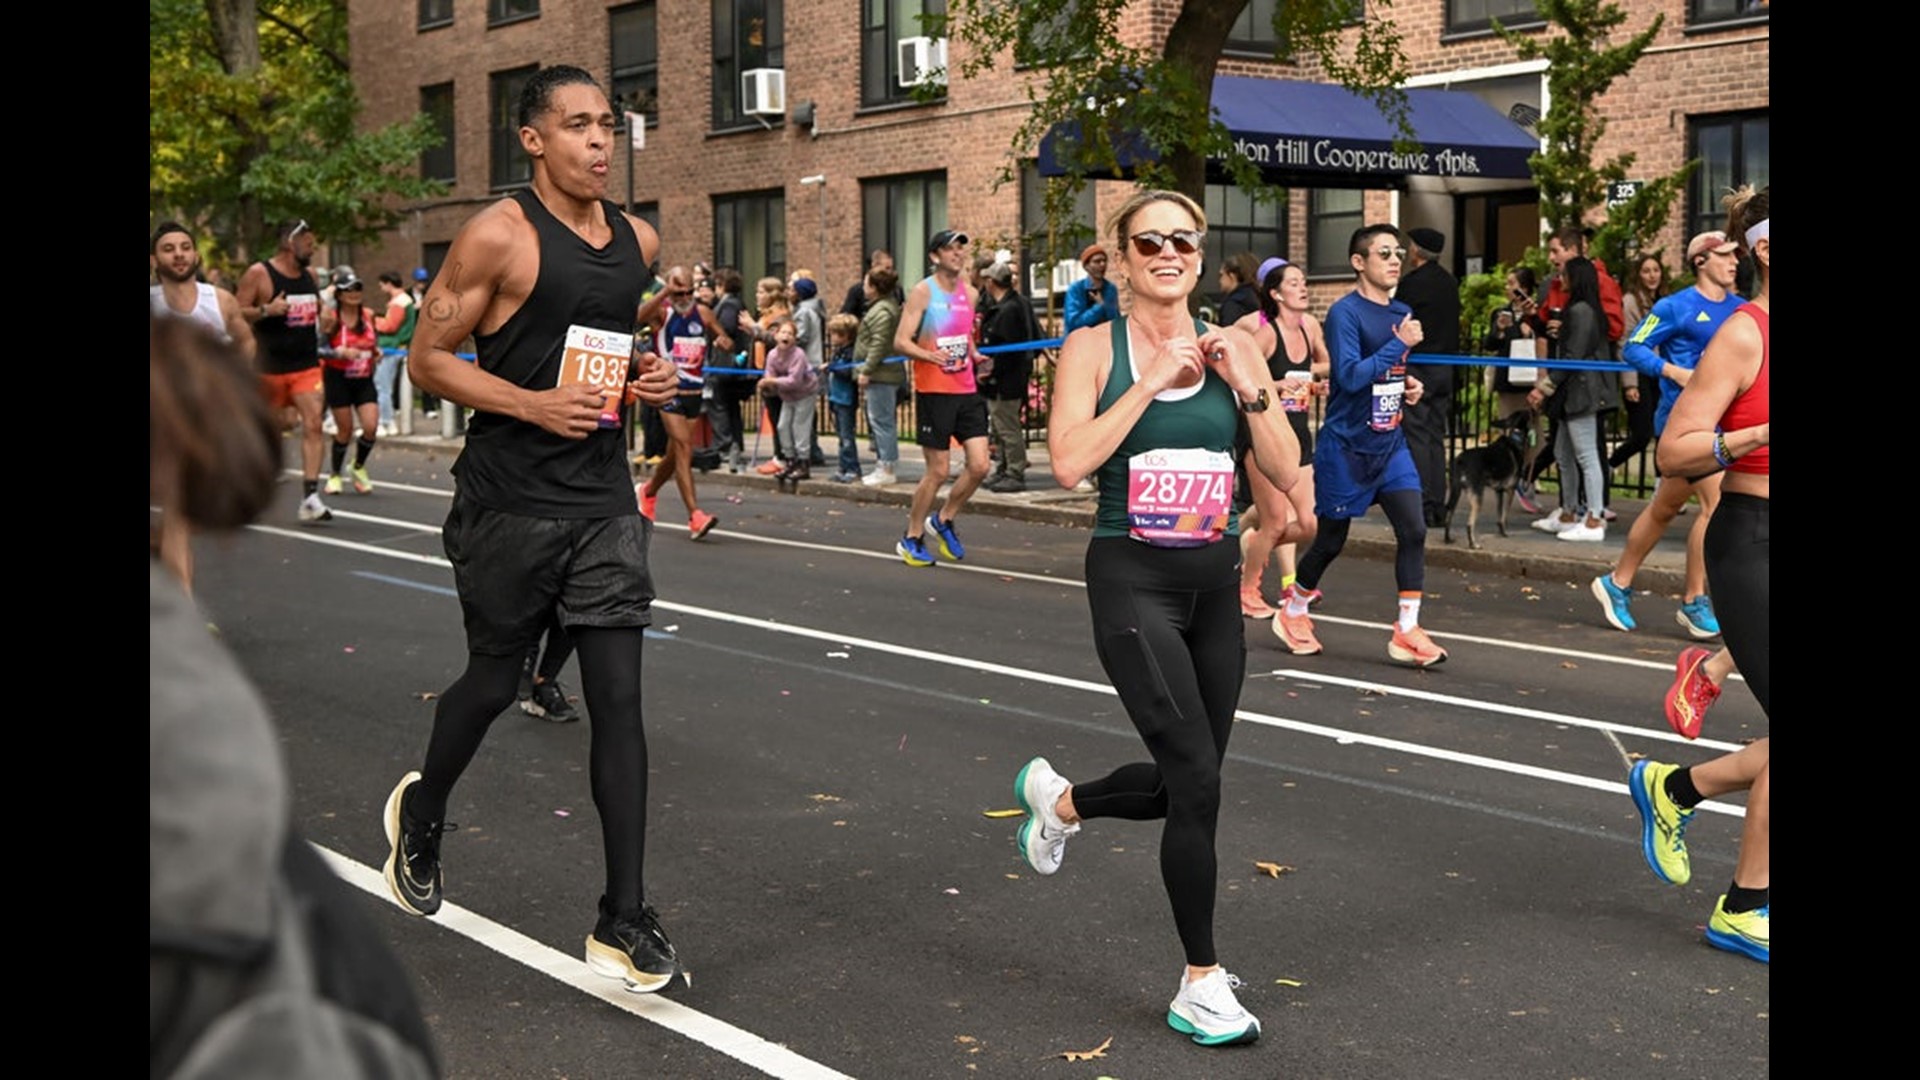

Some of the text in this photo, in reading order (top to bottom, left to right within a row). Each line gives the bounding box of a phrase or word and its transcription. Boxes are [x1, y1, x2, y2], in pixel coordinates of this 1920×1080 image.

[1275, 138, 1309, 165] Hill
[1314, 139, 1430, 173] Cooperative
[1435, 148, 1480, 176] Apts.
[1616, 183, 1636, 198] 325
[583, 334, 606, 350] tcs
[575, 352, 629, 388] 1935
[1138, 472, 1226, 505] 28774
